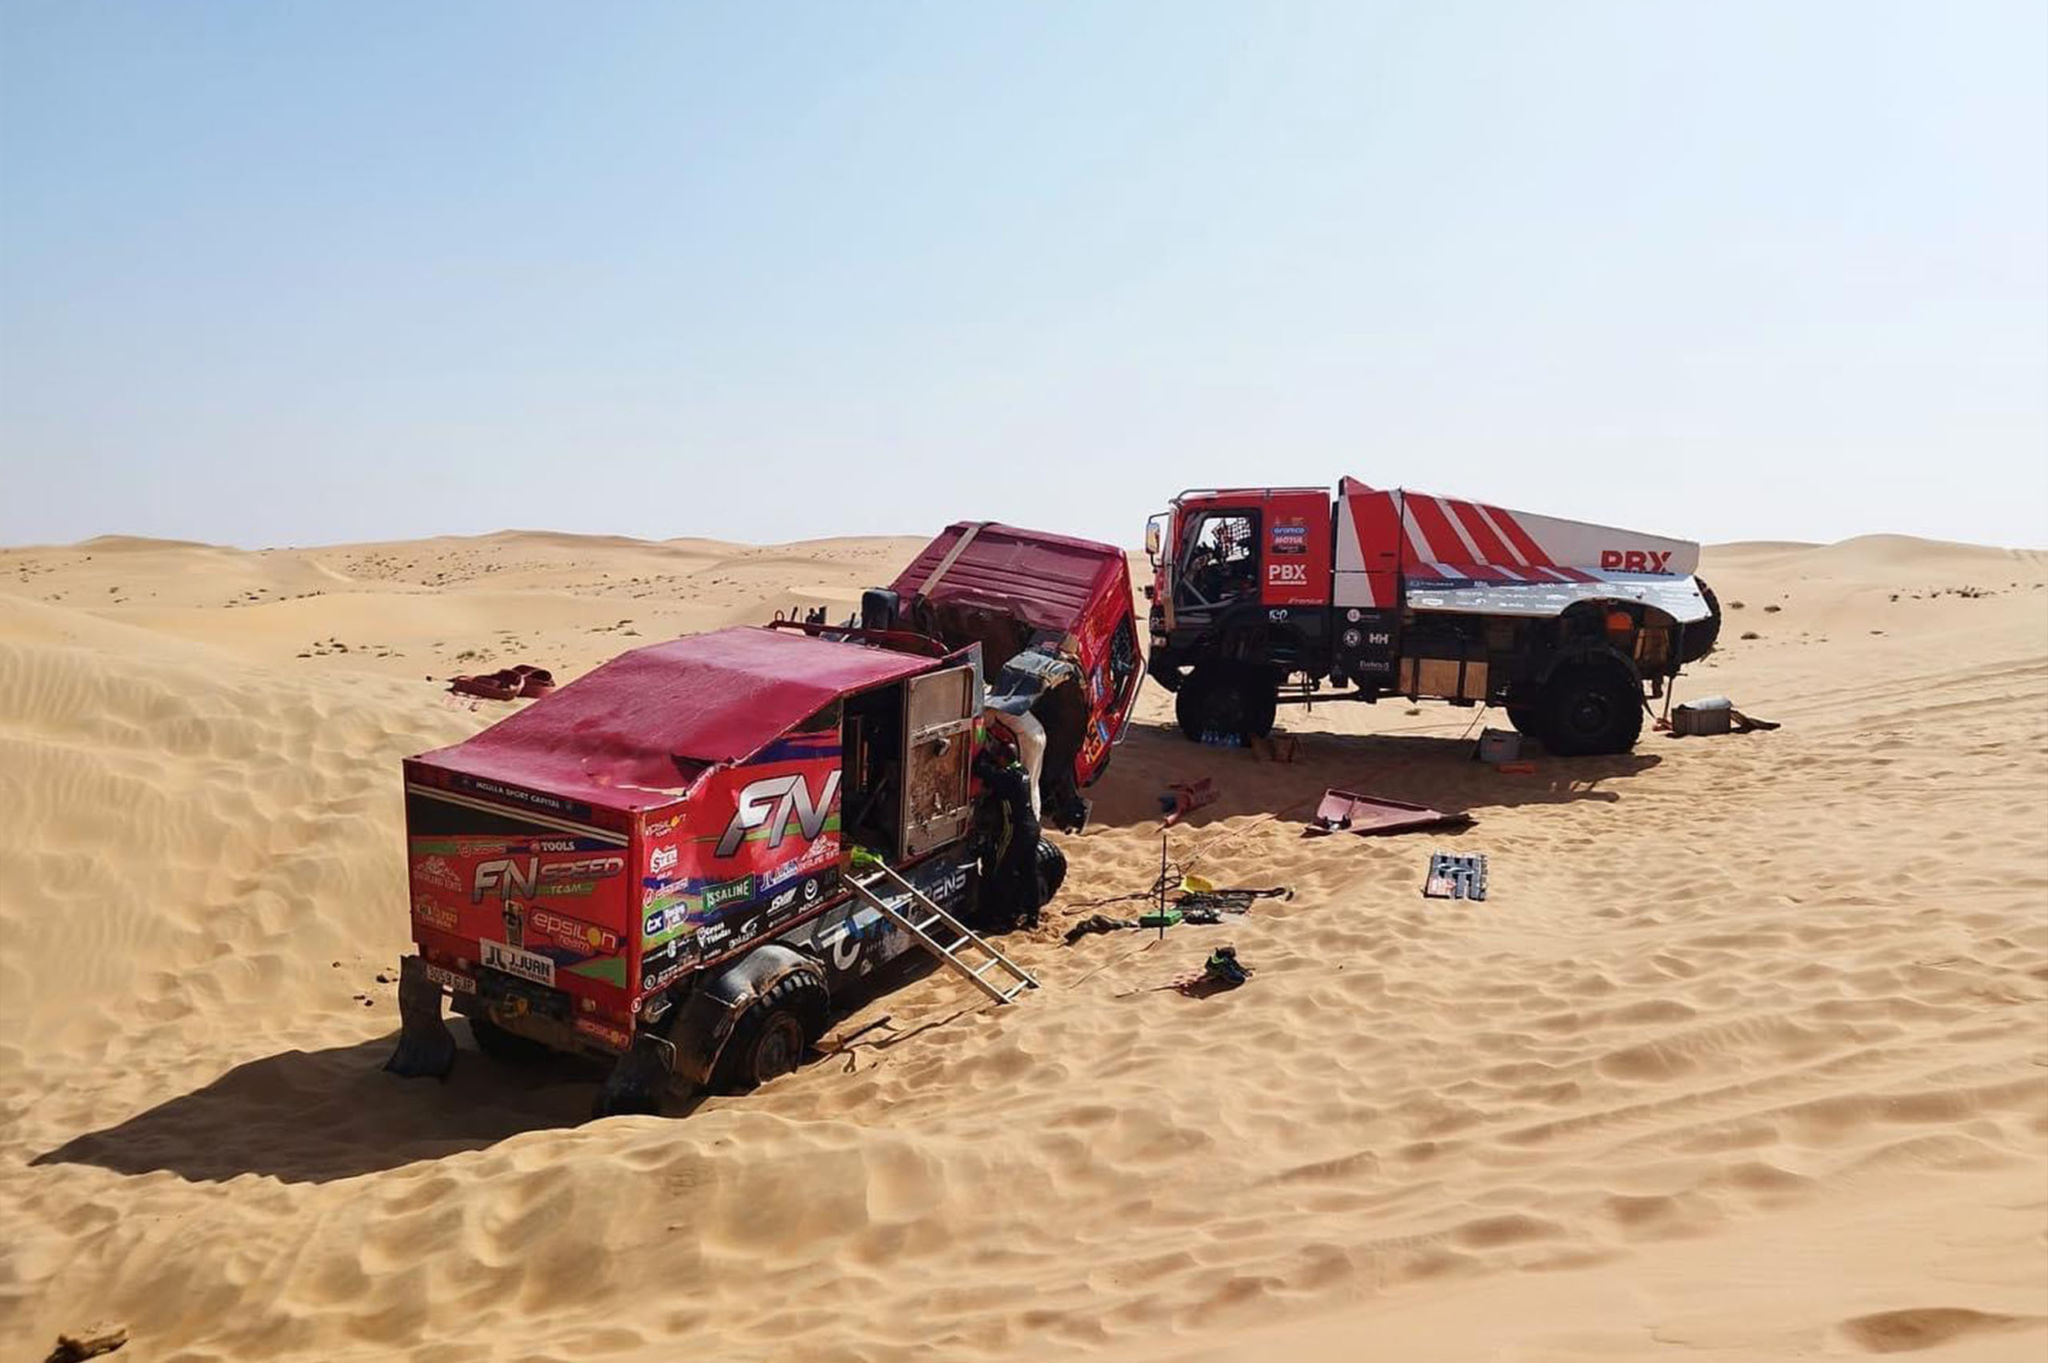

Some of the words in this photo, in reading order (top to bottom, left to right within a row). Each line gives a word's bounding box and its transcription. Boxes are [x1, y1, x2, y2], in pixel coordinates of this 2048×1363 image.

[1268, 564, 1307, 580] PBX
[1369, 633, 1389, 645] HH
[715, 770, 841, 858] FN
[541, 841, 576, 852] TOOLS
[706, 880, 750, 908] ISSALINE
